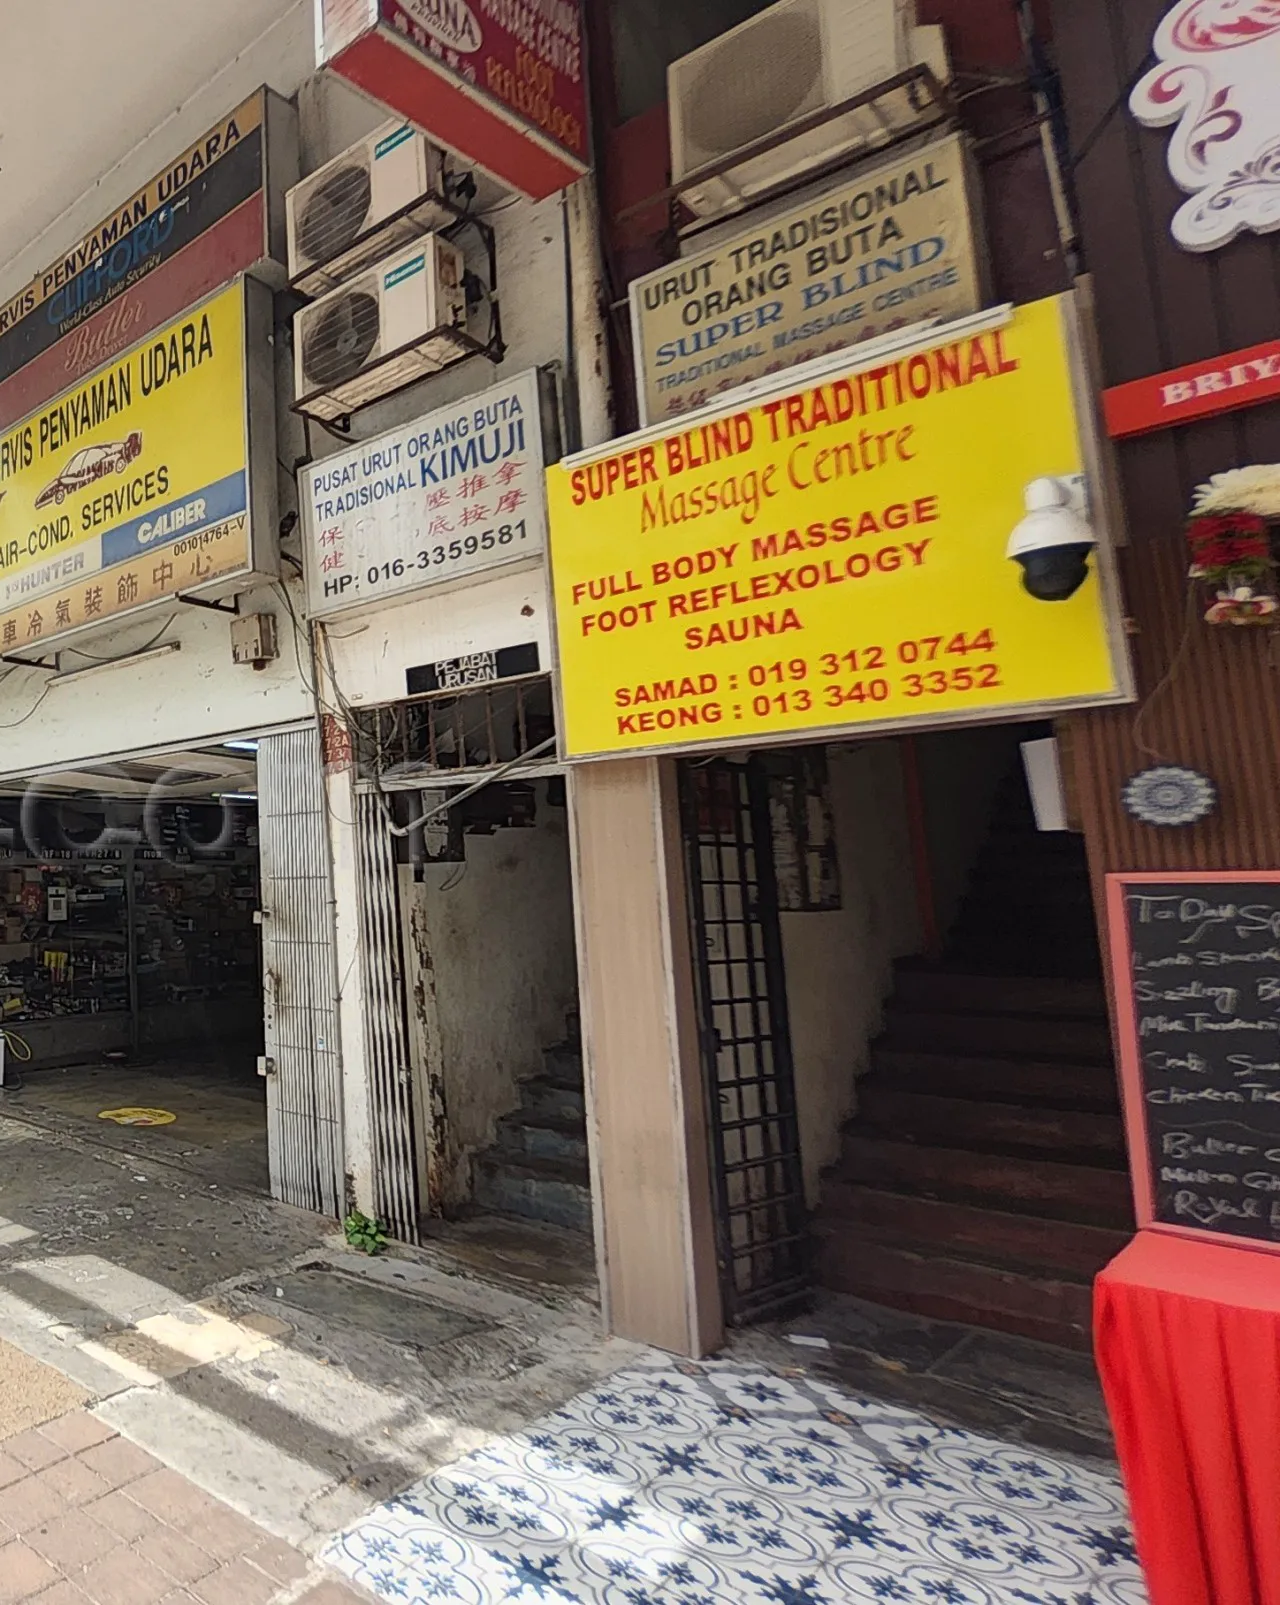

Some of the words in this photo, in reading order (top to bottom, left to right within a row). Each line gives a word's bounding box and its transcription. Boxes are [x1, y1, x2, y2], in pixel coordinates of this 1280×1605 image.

[42, 195, 148, 299] PENYAMAN
[157, 118, 241, 202] UDARA
[643, 259, 719, 312] URUT
[728, 162, 950, 275] TRADISIONAL
[655, 301, 785, 368] SUPER
[800, 236, 947, 312] BLIND
[681, 262, 793, 326] ORANG
[806, 215, 905, 278] BUTA
[40, 362, 132, 458] PENYAMAN
[140, 313, 213, 397] UDARA
[655, 343, 766, 393] TRADITIONAL
[773, 302, 868, 351] MASSAGE
[1160, 353, 1280, 408] BRIY
[313, 461, 358, 496] PUSAT
[362, 444, 401, 484] URUT
[407, 416, 469, 457] ORANG
[473, 394, 523, 432] BUTA
[570, 447, 659, 507] SUPER
[667, 411, 754, 483] BLIND
[765, 328, 1021, 443] TRADITIONAL
[81, 465, 170, 531] SERVICES
[137, 498, 207, 544] CALIBER
[315, 473, 417, 522] TRADISIONAL
[420, 419, 526, 488] KIMUJI
[639, 460, 779, 534] Massage
[787, 422, 919, 498] Centre
[323, 574, 360, 598] HP:
[367, 519, 528, 585] 016-3359581
[571, 572, 643, 606] FULL
[651, 542, 740, 588] BODY
[751, 495, 941, 563] MASSAGE
[581, 601, 658, 638] FOOT
[668, 536, 934, 620] REFLEXOLOGY
[434, 649, 499, 677] PEJABAT
[437, 665, 498, 690] URUSAN
[614, 671, 719, 708] SAMAD
[747, 657, 808, 688] 019
[819, 646, 884, 677] 312
[896, 627, 997, 667] 0744
[683, 606, 805, 651] SAUNA
[615, 701, 723, 736] KEONG
[751, 686, 813, 718] 013
[823, 677, 889, 709] 340
[901, 663, 1003, 698] 3352
